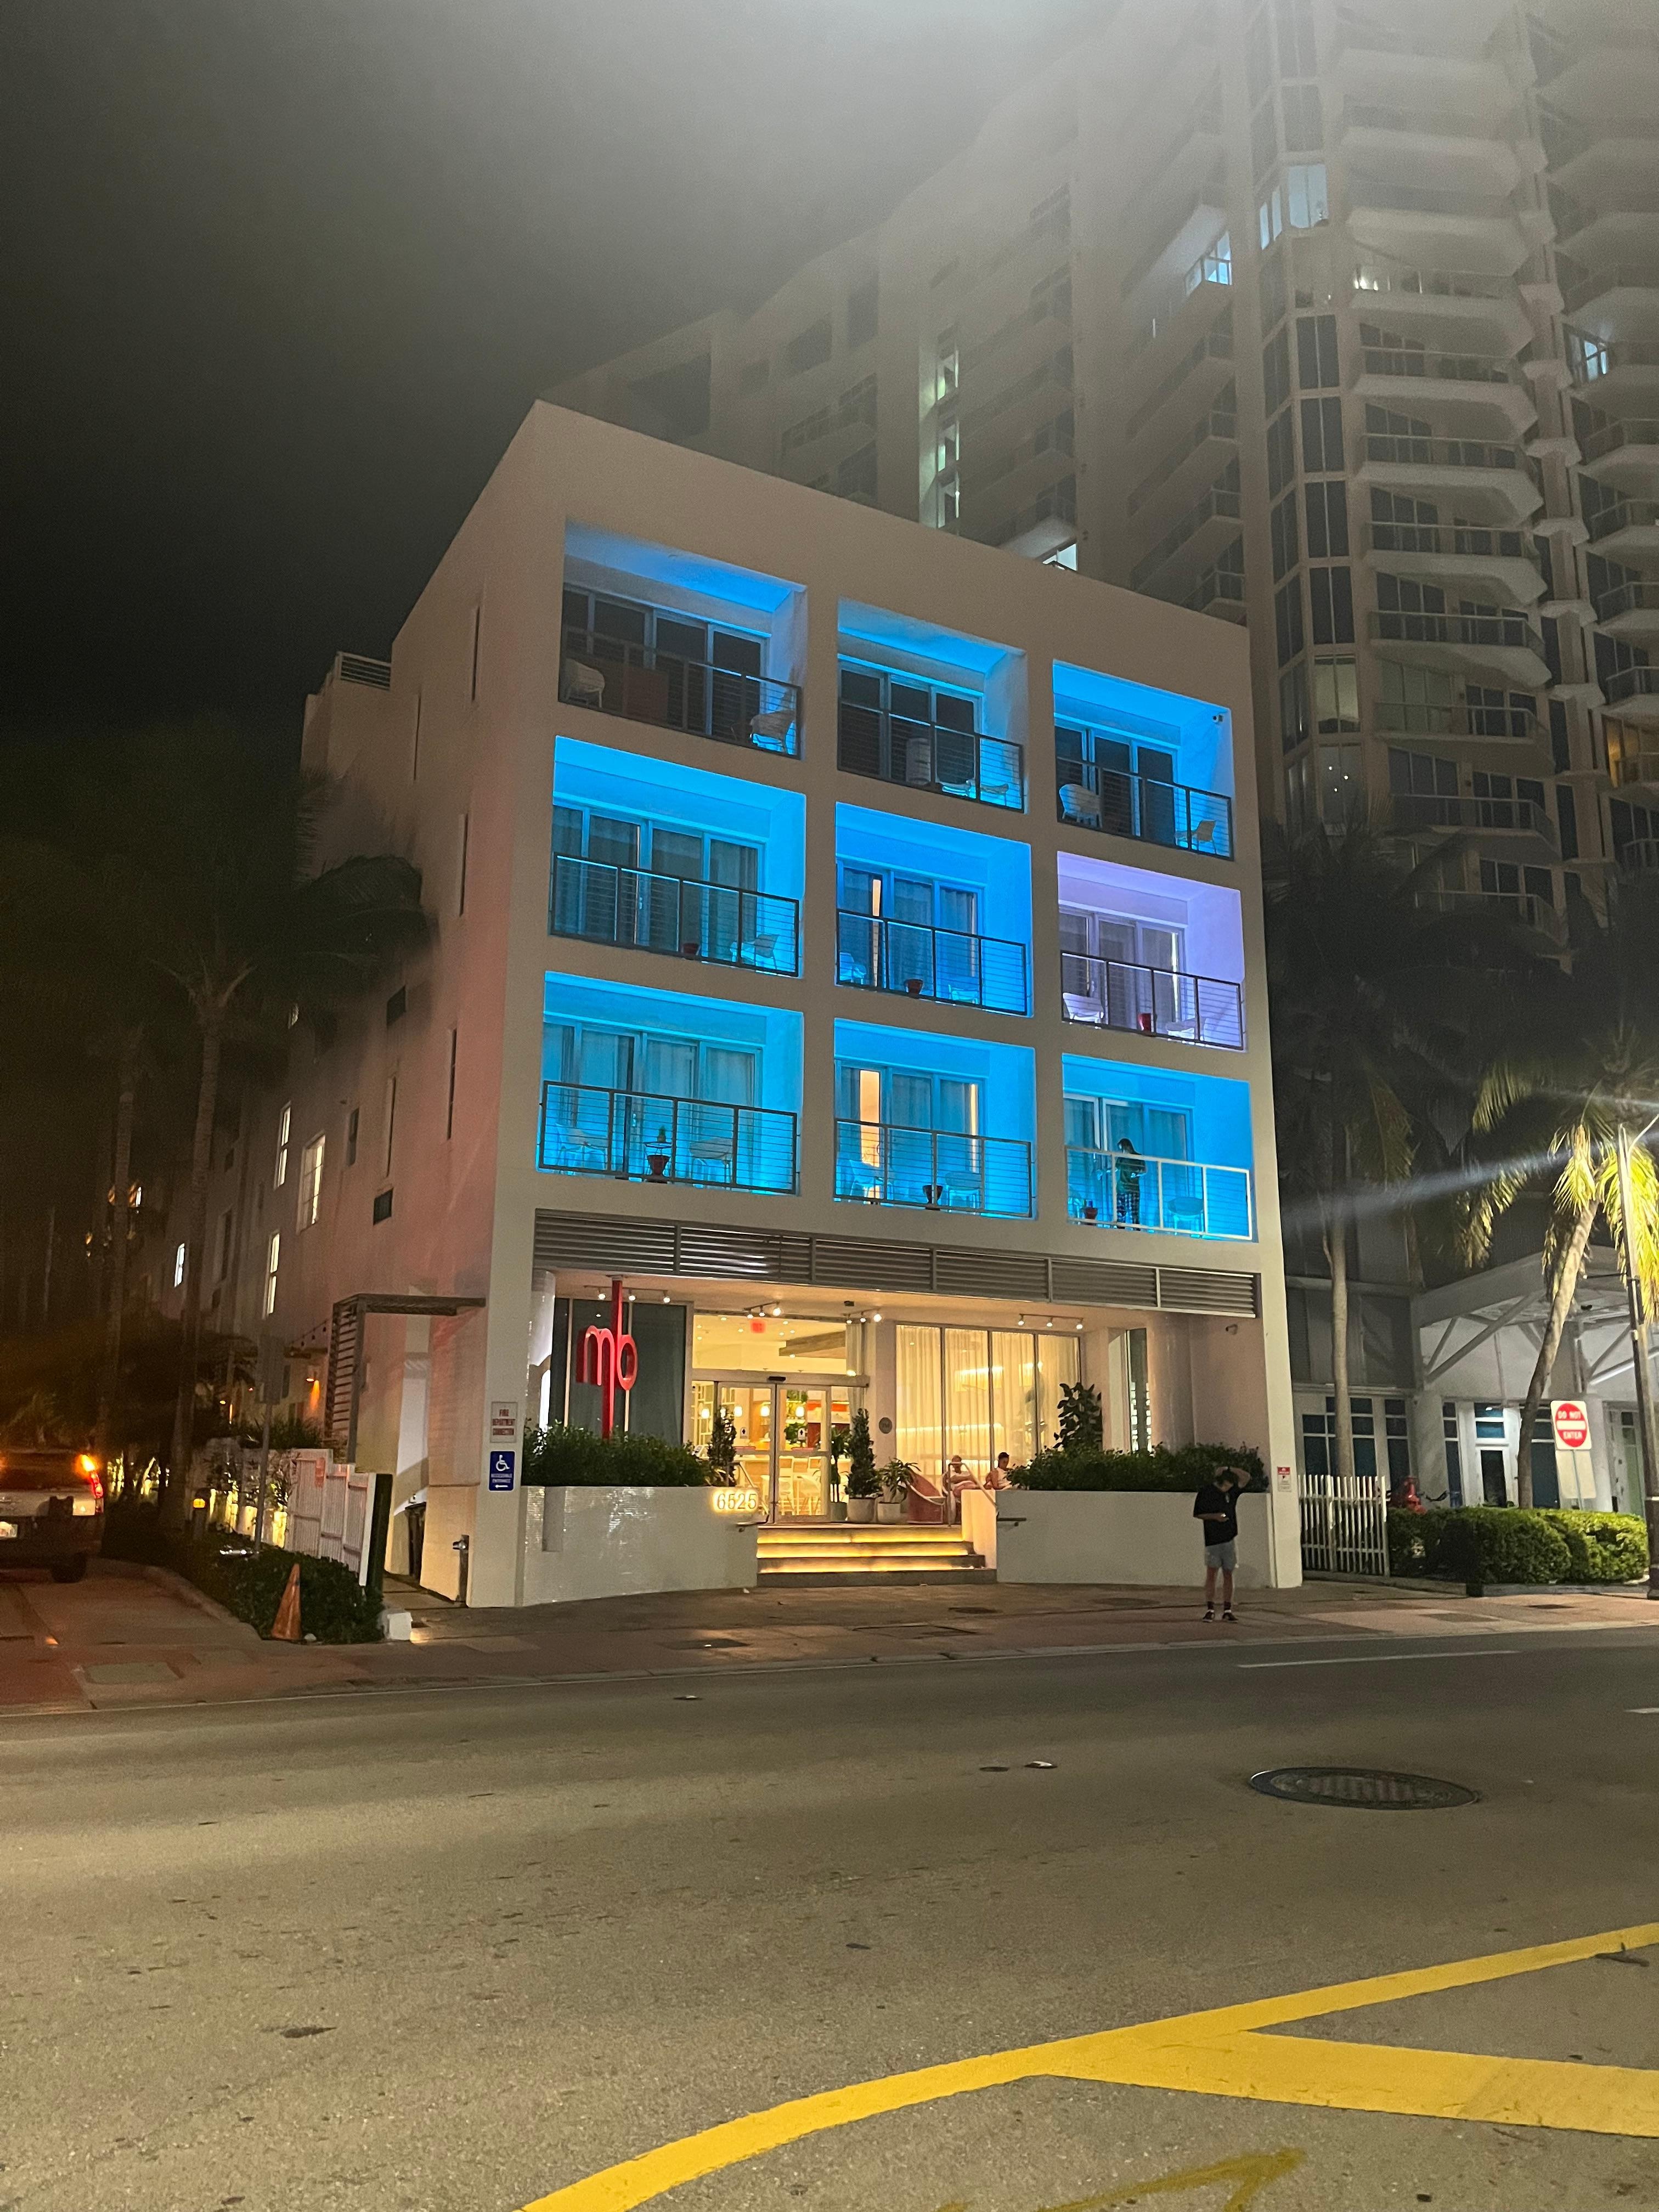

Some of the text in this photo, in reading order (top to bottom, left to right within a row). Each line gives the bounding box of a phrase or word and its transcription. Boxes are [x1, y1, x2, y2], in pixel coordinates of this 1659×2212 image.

[1558, 1410, 1581, 1419] DO NOT
[1562, 1431, 1583, 1440] ENTER
[716, 1492, 757, 1510] 6525
